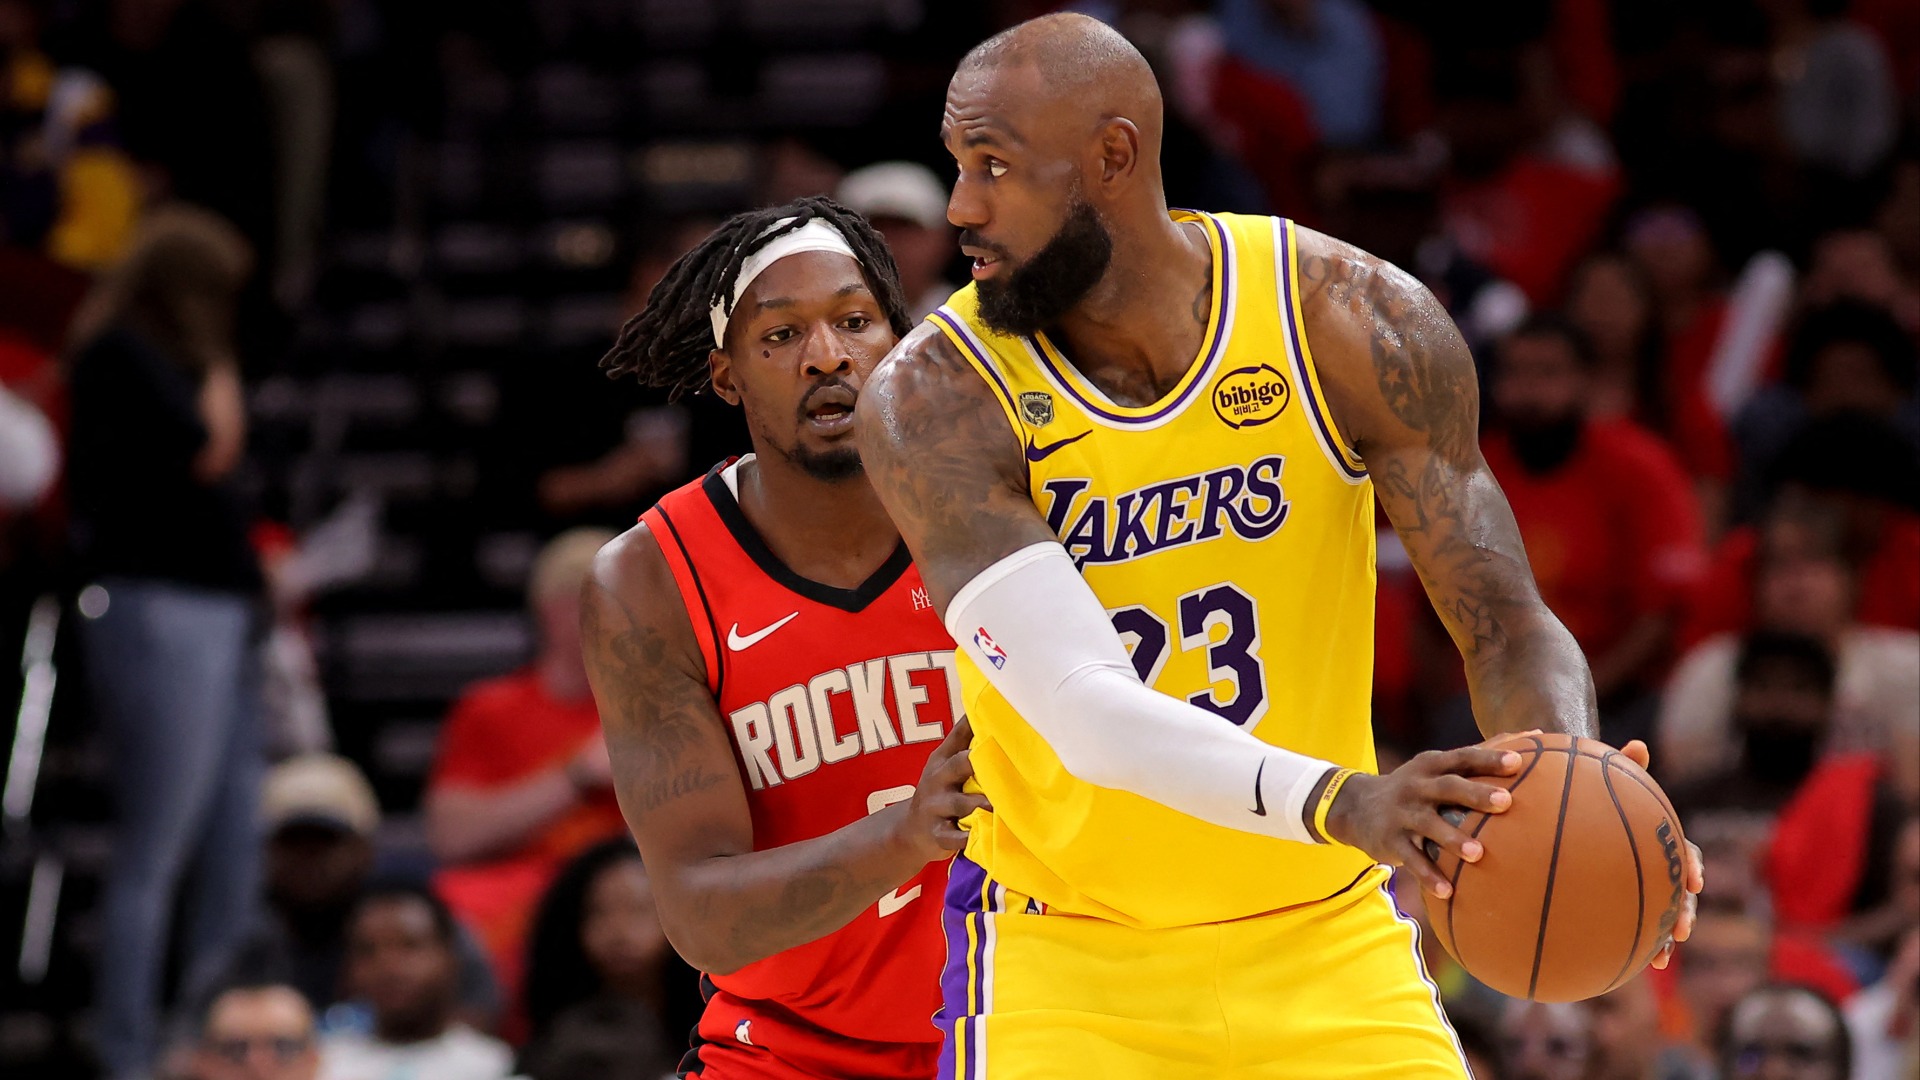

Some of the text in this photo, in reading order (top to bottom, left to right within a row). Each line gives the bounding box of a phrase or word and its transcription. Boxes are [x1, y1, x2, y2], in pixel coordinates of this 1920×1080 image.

[1218, 382, 1285, 408] bibigo
[1233, 402, 1261, 416] 비비고
[1041, 454, 1292, 576] LAKERS
